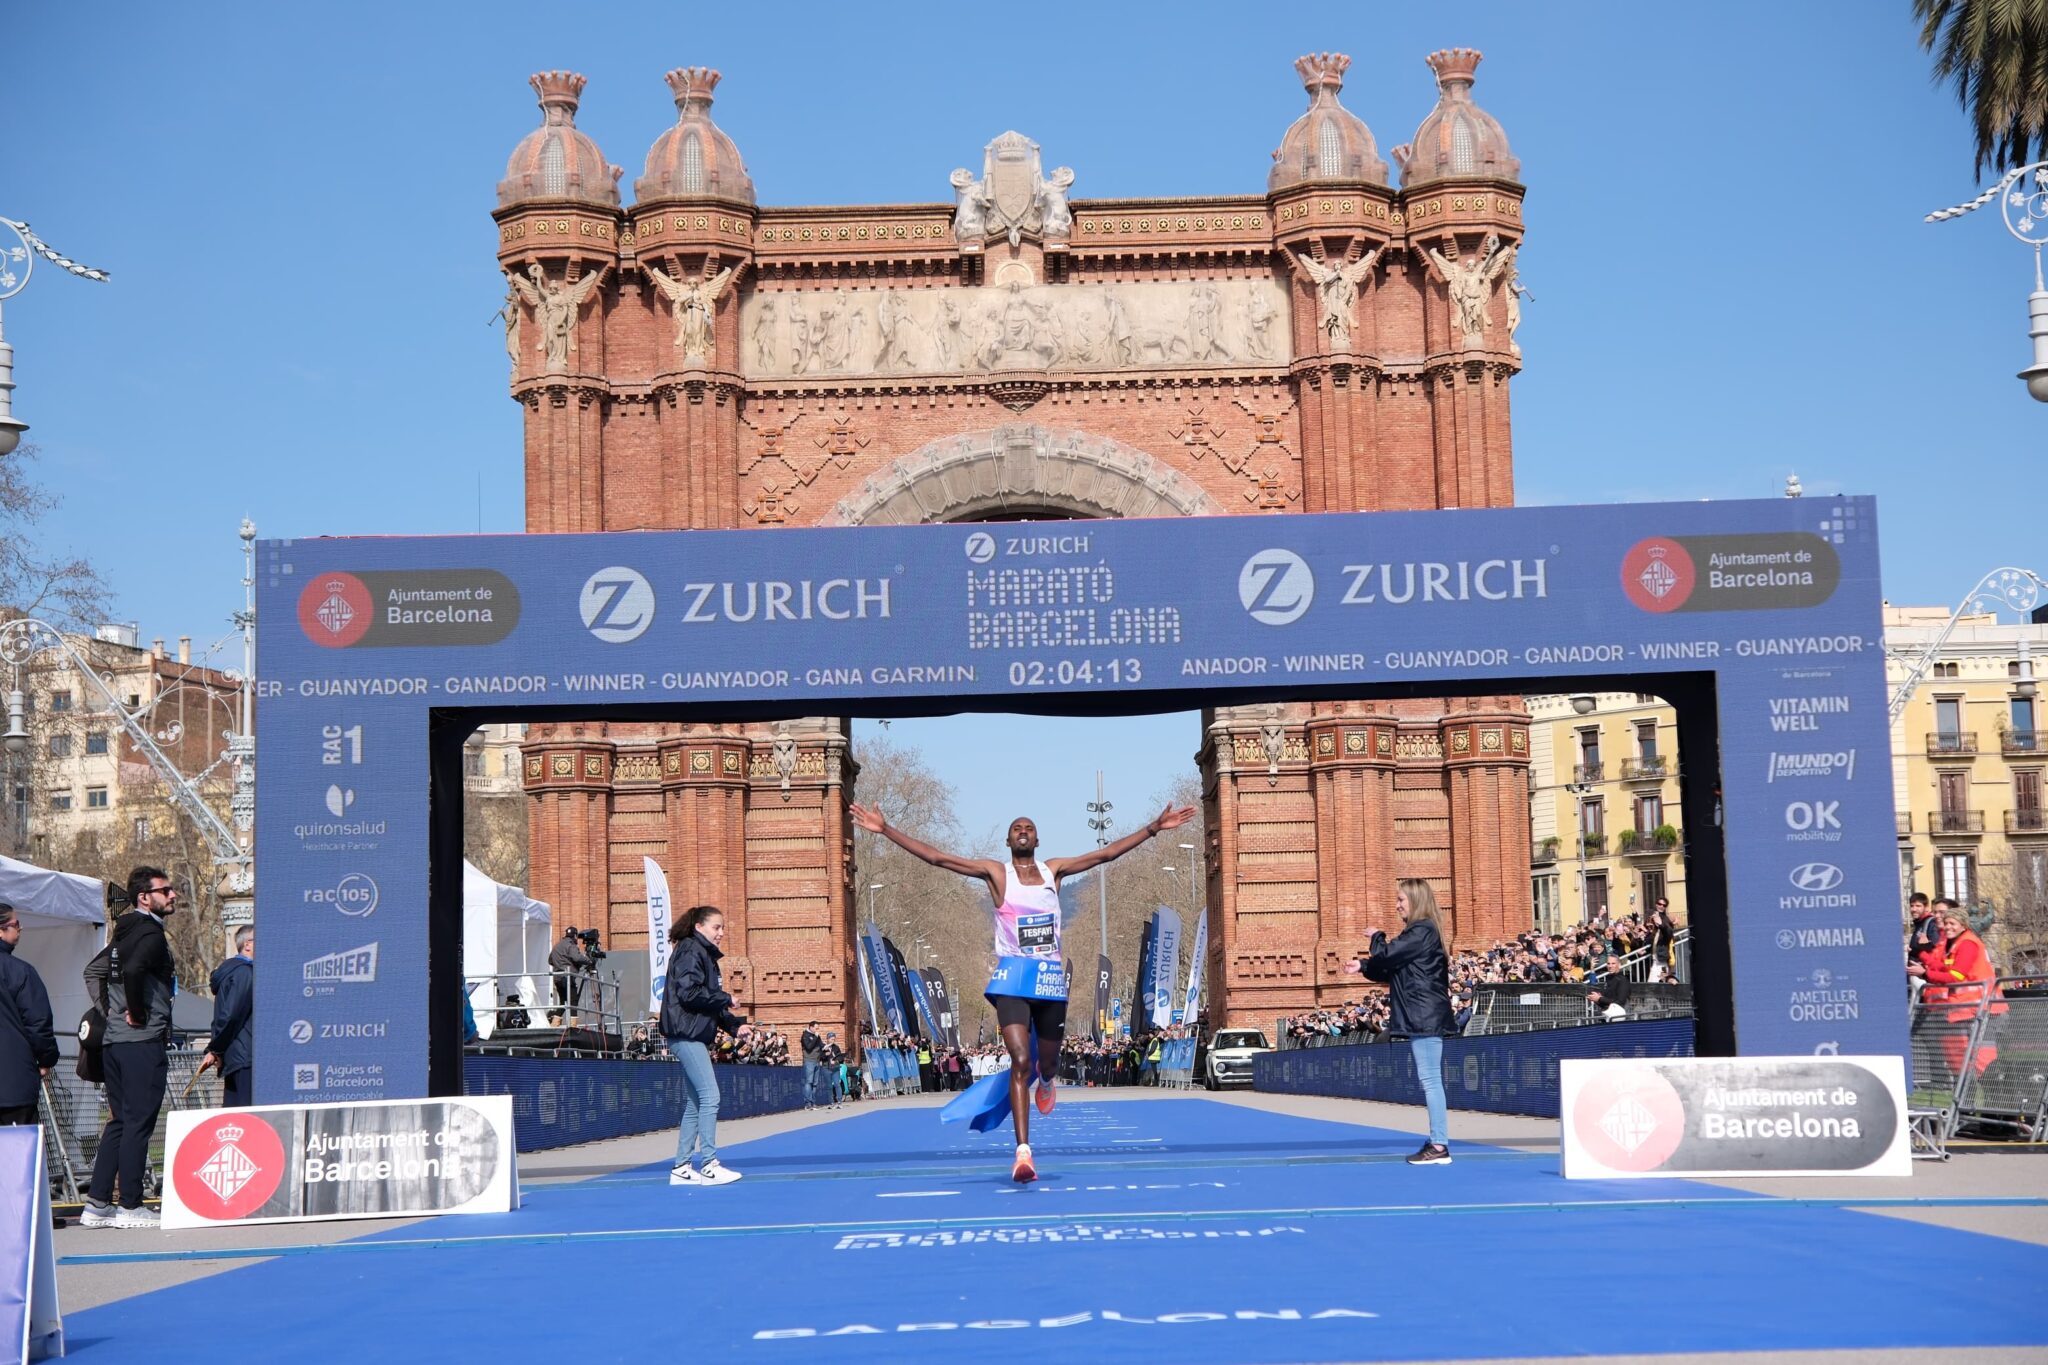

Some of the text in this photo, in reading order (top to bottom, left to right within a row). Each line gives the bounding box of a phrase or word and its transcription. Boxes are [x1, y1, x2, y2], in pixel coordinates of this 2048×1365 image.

[1006, 535, 1090, 555] ZURICH
[1708, 550, 1812, 567] Ajuntament de
[967, 559, 1113, 606] MARATÓ
[1340, 558, 1548, 605] ZURICH
[1709, 569, 1813, 588] Barcelona
[388, 586, 493, 604] Ajuntament de
[681, 577, 892, 623] ZURICH
[387, 605, 493, 625] Barcelona
[968, 606, 1181, 649] BARCELONA
[1182, 656, 1267, 676] ANADOR
[1284, 653, 1364, 672] WINNER
[1385, 648, 1508, 669] GUANYADOR
[1525, 644, 1624, 665] GANADOR
[1640, 641, 1719, 660] WINNER
[1736, 635, 1863, 657] GUANYADOR
[257, 665, 976, 697] ER GUANYADOR GANADOR WINNER GUANYADOR GANA GARMIN
[1009, 658, 1142, 686] 02:04:13
[1769, 696, 1849, 715] VITAMIN
[1770, 715, 1819, 732] WELL
[322, 725, 362, 765] RAC 1
[1777, 752, 1848, 769] MUNDO
[1776, 767, 1832, 777] DEPORTIVO
[1785, 800, 1842, 830] OK
[1787, 830, 1831, 842] mobility
[341, 887, 370, 901] 105
[1780, 894, 1856, 909] HYUNDAI
[1797, 928, 1865, 947] YAMAHA
[305, 952, 371, 978] FINISHER
[1790, 989, 1857, 1004] AMETLLER
[1789, 1003, 1859, 1021] ORIGEN
[320, 1023, 386, 1038] ZURICH
[324, 1064, 383, 1079] Aigües de
[325, 1076, 384, 1087] Barcelona
[1703, 1087, 1858, 1110] Ajuntament de
[1704, 1113, 1861, 1139] Barcelona
[306, 1130, 430, 1156] Ajuntament
[304, 1157, 461, 1183] Barcelona
